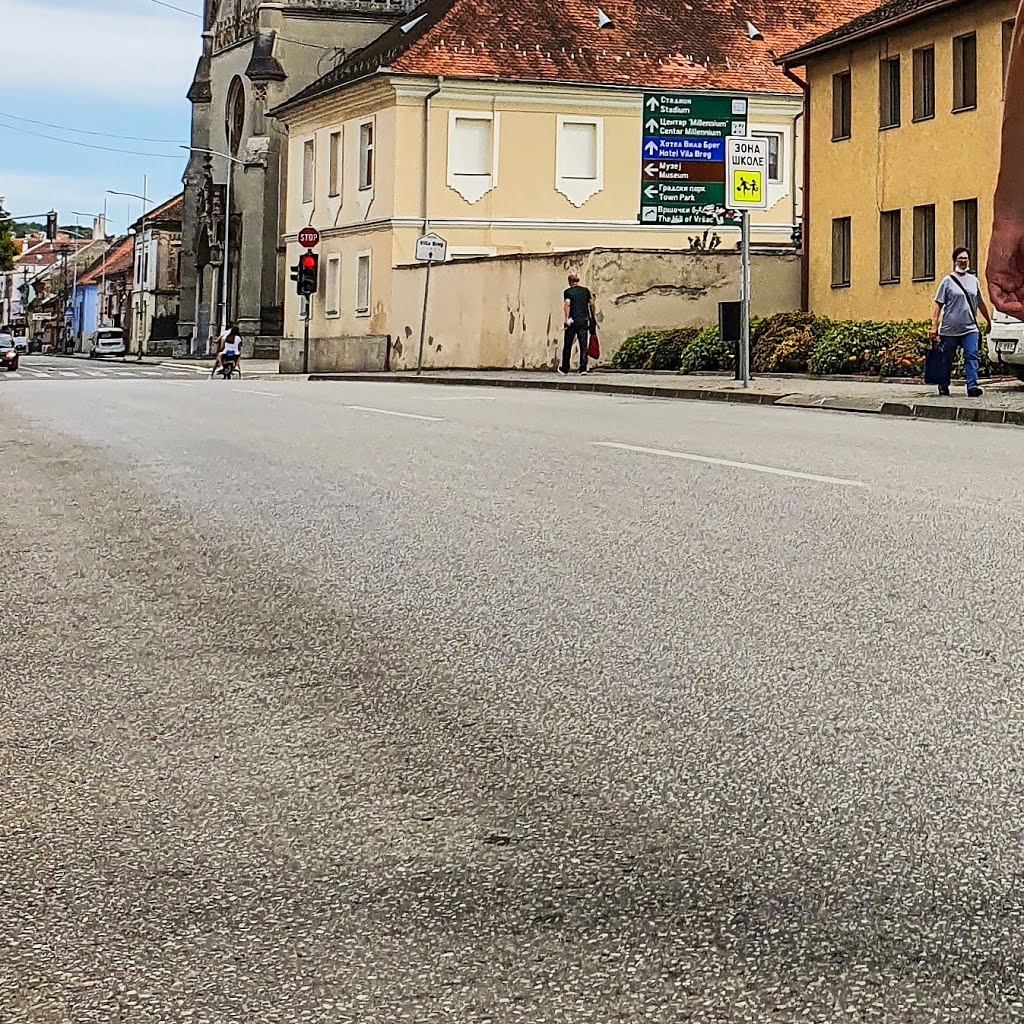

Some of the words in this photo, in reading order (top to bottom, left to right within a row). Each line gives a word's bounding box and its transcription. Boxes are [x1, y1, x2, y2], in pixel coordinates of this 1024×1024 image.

[660, 96, 692, 105] Стадион
[660, 105, 691, 114] Stadium
[660, 118, 687, 127] Центар
[660, 127, 683, 135] Centar
[660, 140, 683, 148] Хотел
[684, 140, 702, 148] Вила
[703, 141, 720, 150] Брег
[734, 143, 761, 154] ЗОНА
[659, 149, 679, 157] Hotel
[680, 150, 694, 158] Vila
[695, 150, 712, 160] Breg
[732, 155, 765, 166] ШКОЛЕ
[659, 162, 682, 171] Музеј
[659, 171, 689, 179] Museum
[659, 184, 688, 192] Градски
[659, 193, 679, 201] Town
[658, 215, 671, 223] The
[685, 215, 692, 223] of
[300, 234, 318, 242] STOP
